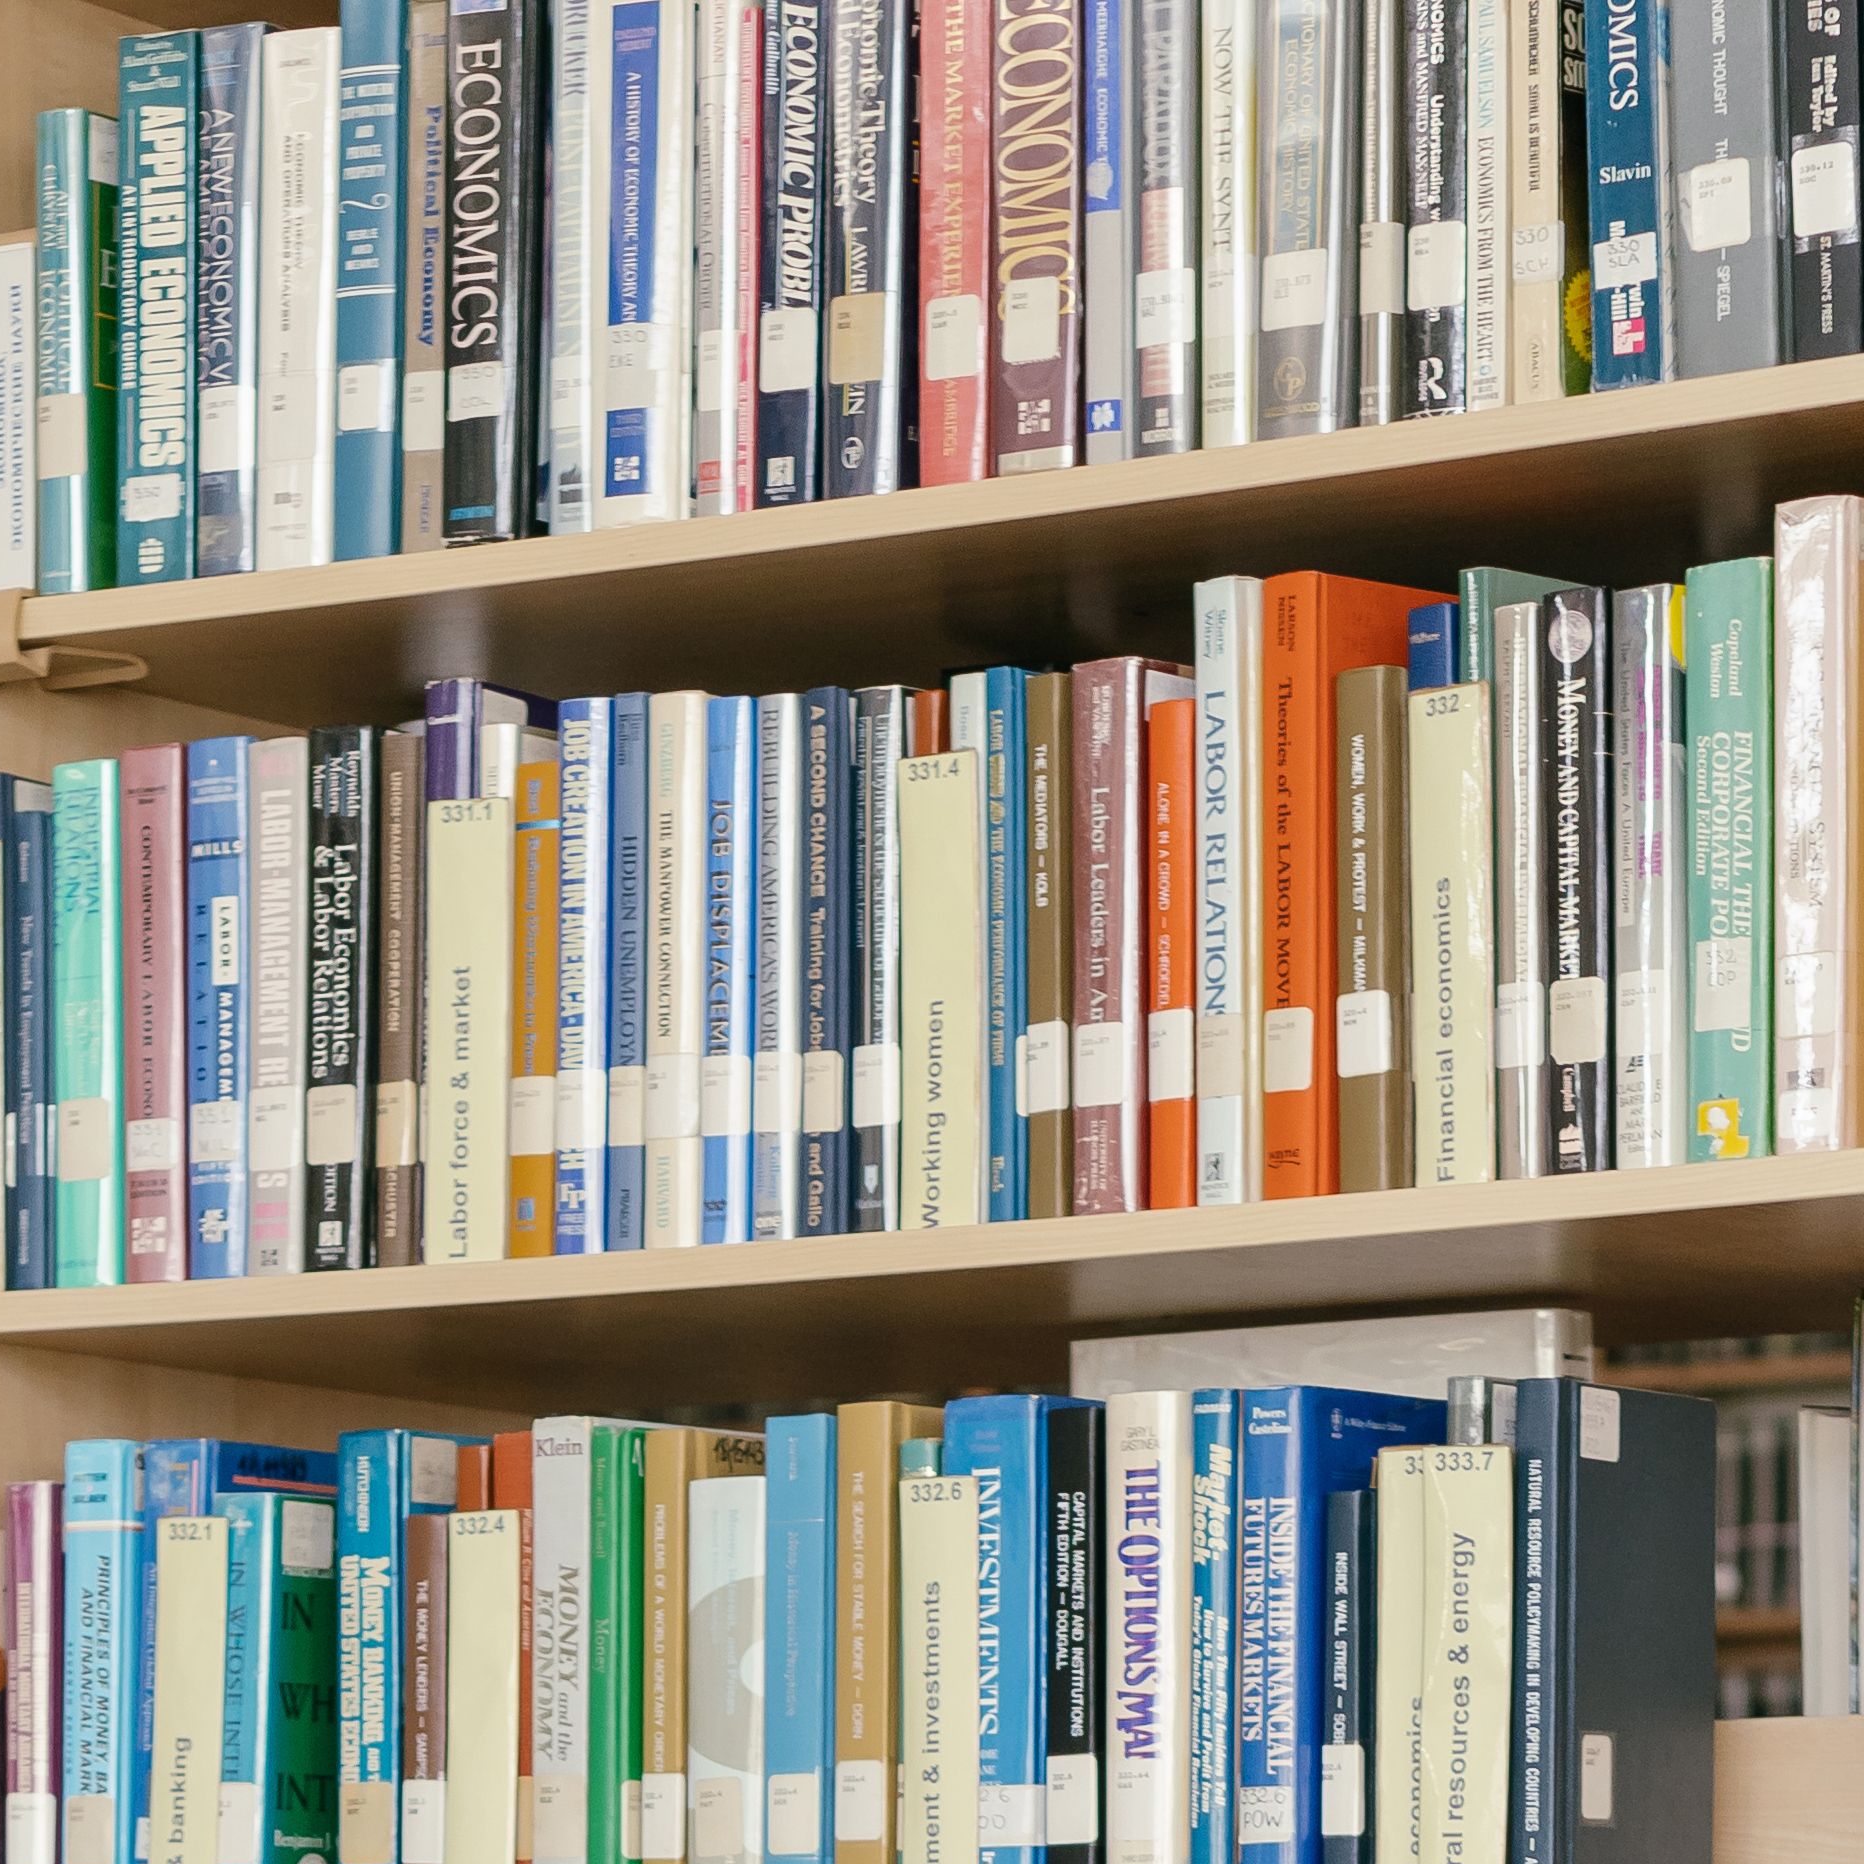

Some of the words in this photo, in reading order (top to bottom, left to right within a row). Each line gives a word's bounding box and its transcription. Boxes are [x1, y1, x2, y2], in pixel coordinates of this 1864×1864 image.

[137, 105, 186, 247] APPLIED
[452, 40, 502, 350] ECONOMICS
[1599, 162, 1651, 184] Slavin
[139, 251, 186, 468] ECONOMICS
[1426, 692, 1459, 716] 332
[907, 759, 961, 782] 331.4
[440, 803, 494, 824] 331.1
[1435, 876, 1453, 1037] economics
[453, 965, 470, 1065] market
[925, 998, 945, 1100] women
[451, 1074, 467, 1095] &
[1437, 1045, 1456, 1182] Financial
[449, 1100, 470, 1171] force
[920, 1108, 948, 1228] Working
[449, 1179, 467, 1259] Labor
[535, 1438, 584, 1458] Klein
[1434, 1451, 1494, 1472] 333.7
[455, 1516, 506, 1537] 332.4
[910, 1481, 962, 1502] 332.6
[168, 1523, 213, 1541] 332.1
[978, 1466, 1001, 1738] INVESTMENTS
[1451, 1532, 1477, 1636] energy
[922, 1581, 940, 1756] investments
[1447, 1644, 1470, 1664] &
[166, 1737, 192, 1842] banking
[922, 1763, 940, 1784] &
[1447, 1675, 1472, 1824] resources
